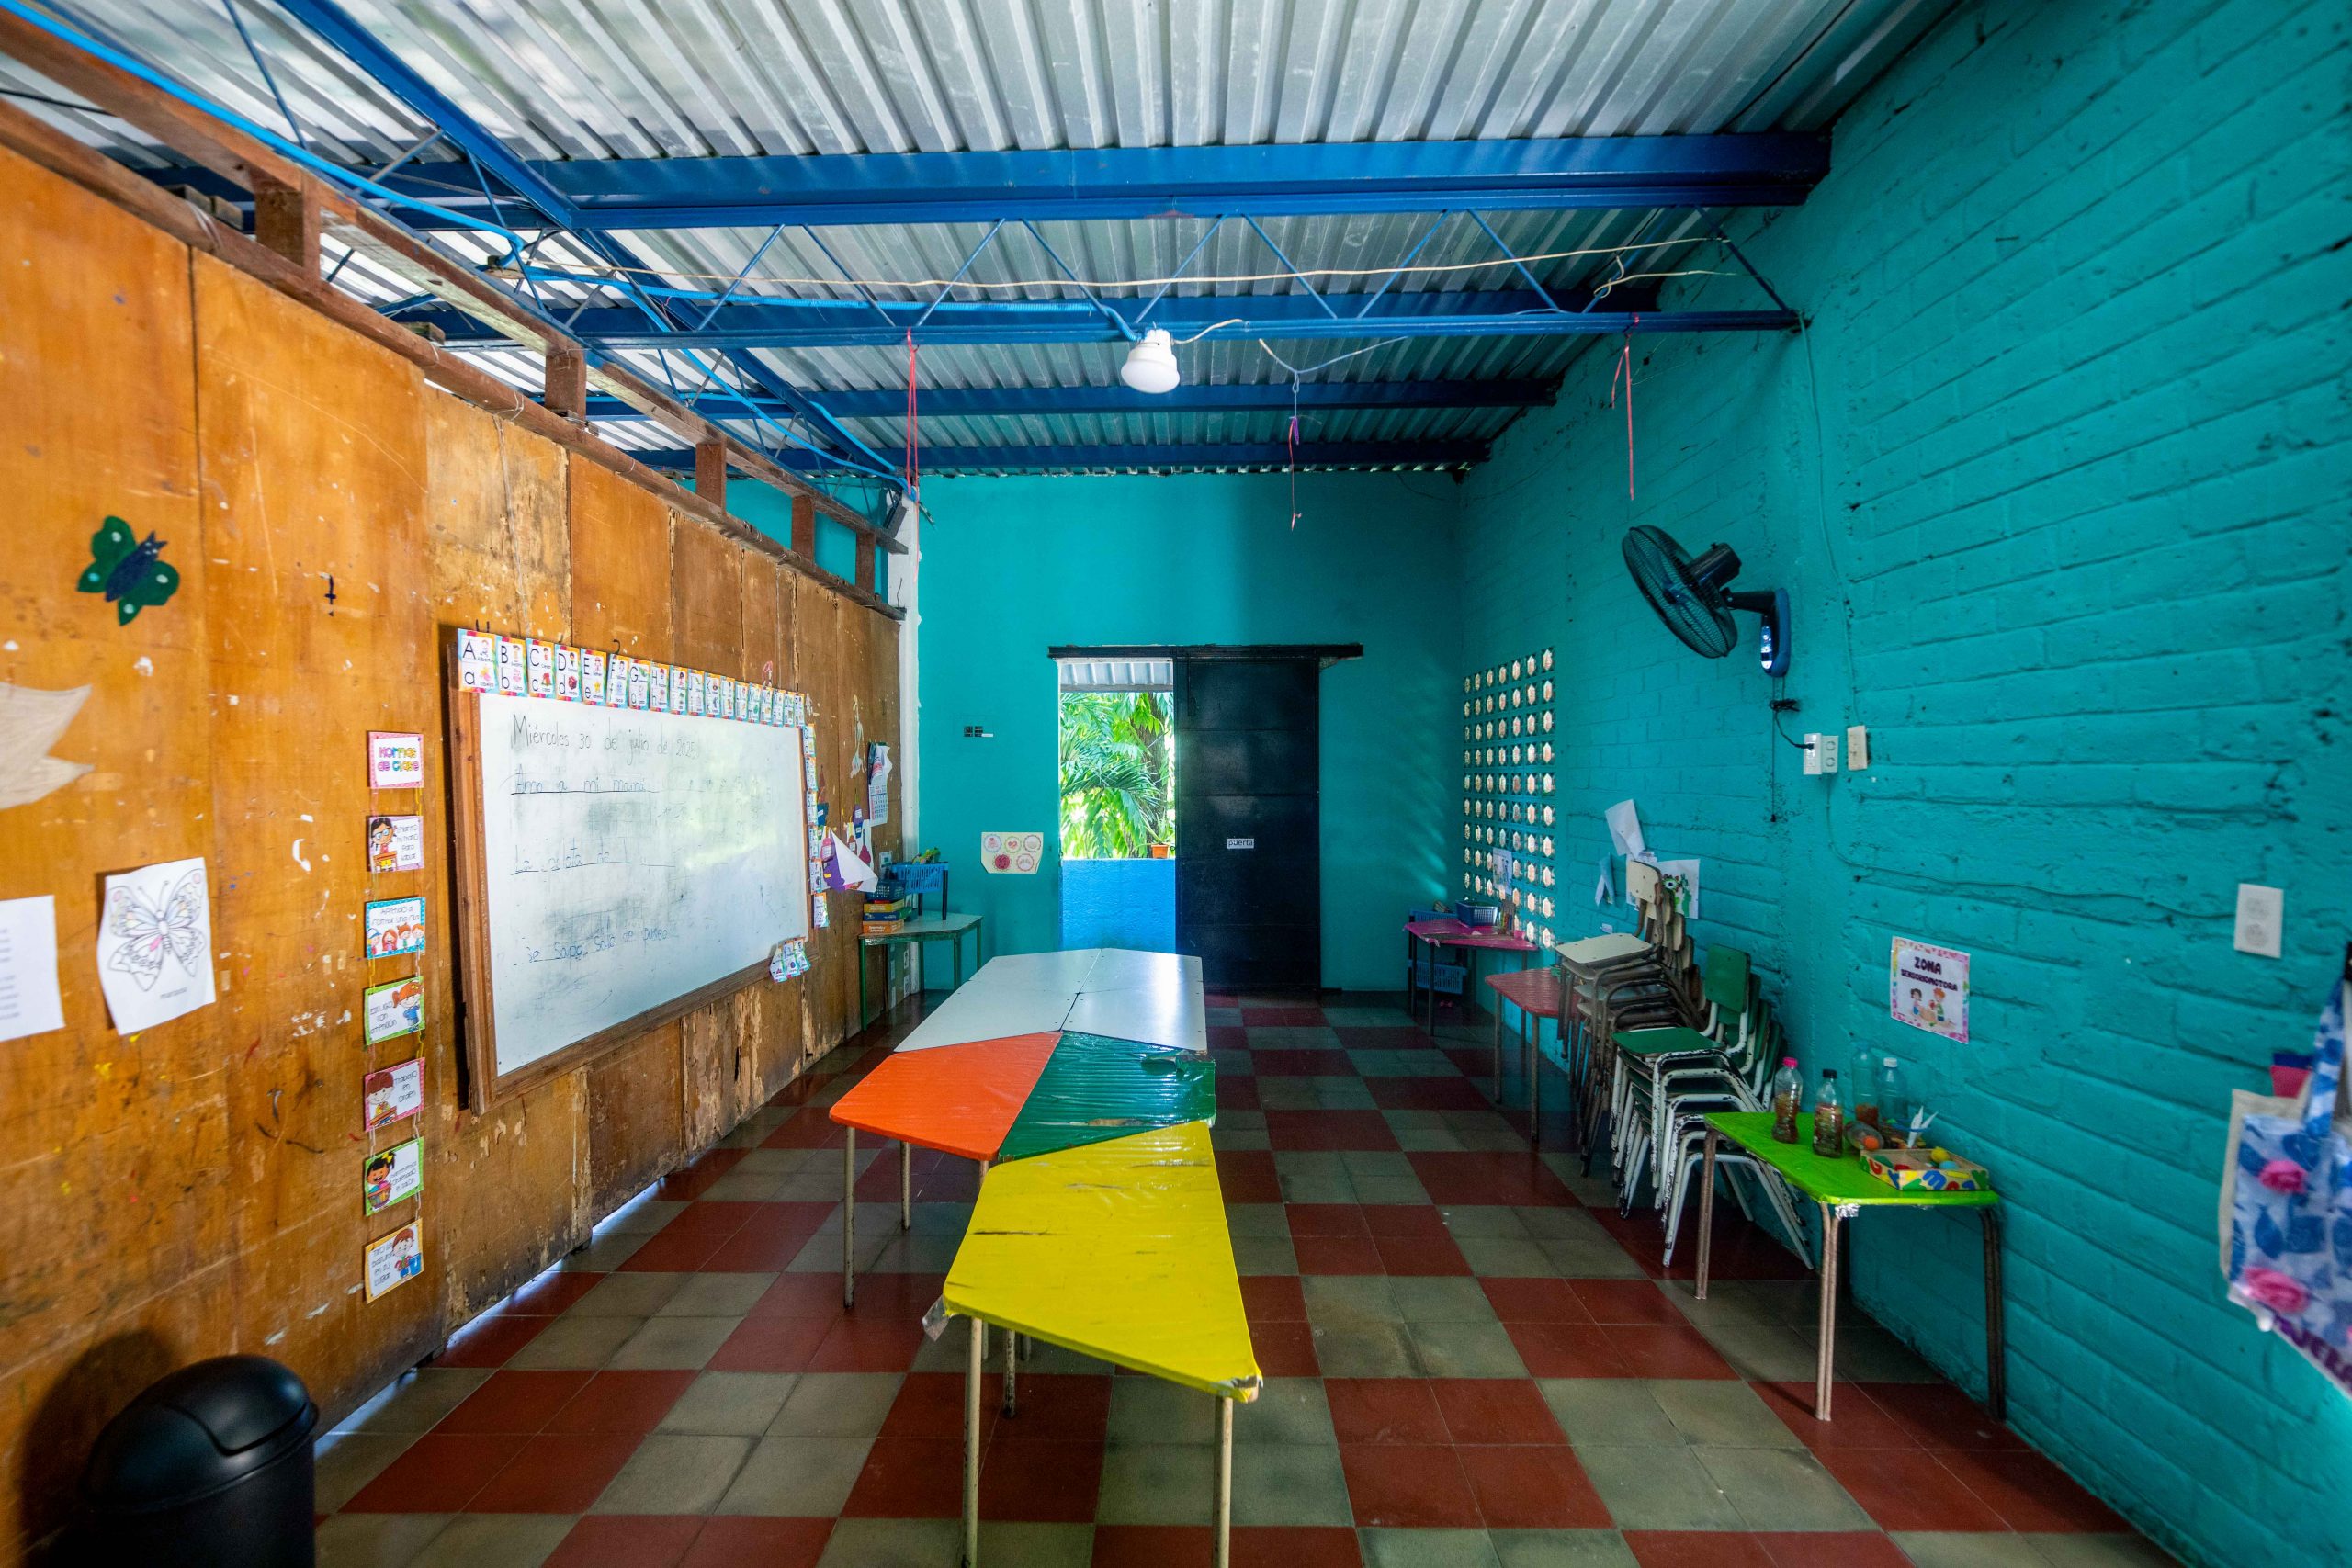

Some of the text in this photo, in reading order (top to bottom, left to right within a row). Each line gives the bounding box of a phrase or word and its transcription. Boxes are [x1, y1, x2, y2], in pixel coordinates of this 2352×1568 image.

[462, 640, 476, 660] A
[501, 645, 509, 663] B
[529, 648, 539, 667] C
[558, 652, 567, 671] D
[583, 657, 590, 675] E
[464, 671, 476, 685] a
[501, 667, 510, 690] b
[629, 666, 639, 682] G
[559, 674, 566, 694] d
[584, 686, 592, 699] e
[512, 713, 570, 749] Miércoles
[579, 733, 592, 750] 30
[604, 716, 618, 750] de
[625, 726, 650, 766] julio
[656, 722, 669, 755] de
[379, 747, 417, 759] Normas
[378, 761, 390, 773] de
[514, 763, 543, 793] Amo
[558, 780, 568, 791] a
[583, 777, 600, 792] mi
[1914, 955, 1942, 976] ZONA
